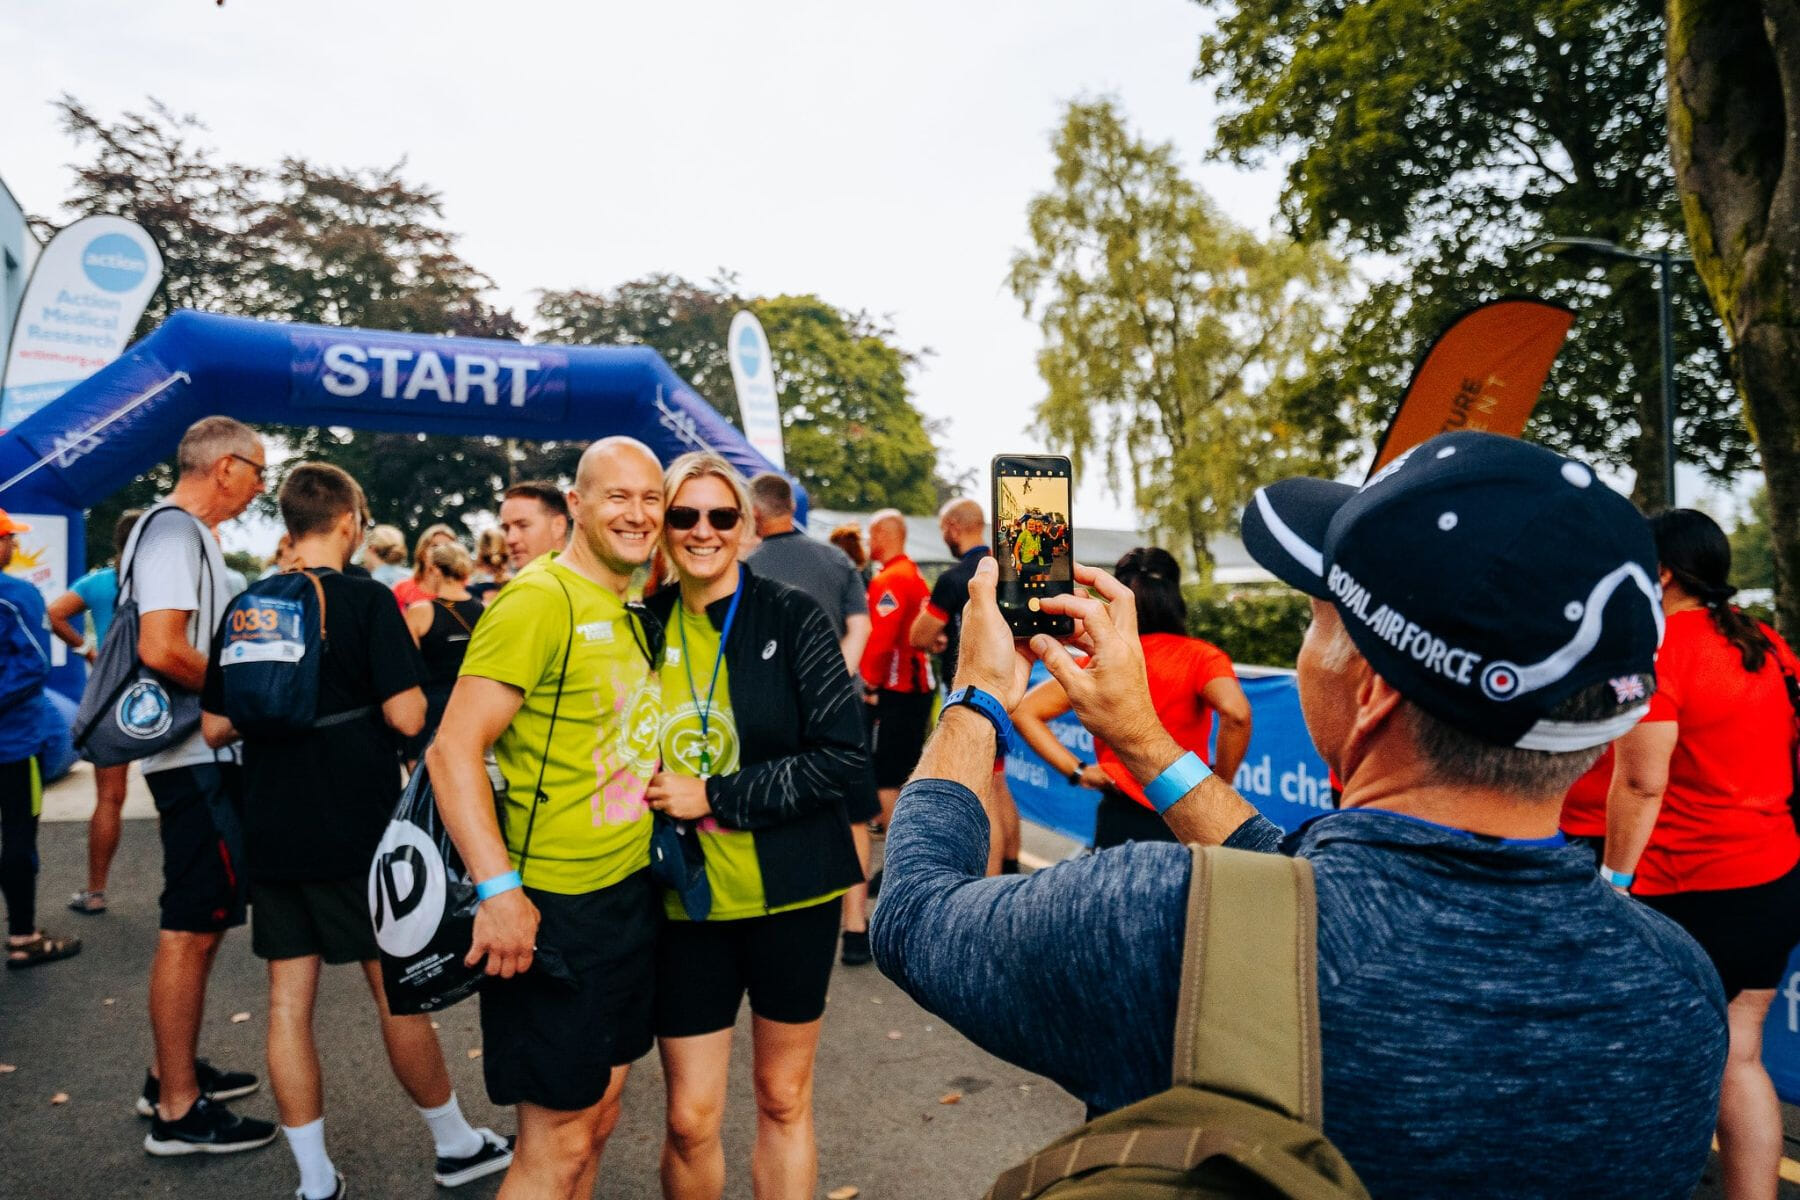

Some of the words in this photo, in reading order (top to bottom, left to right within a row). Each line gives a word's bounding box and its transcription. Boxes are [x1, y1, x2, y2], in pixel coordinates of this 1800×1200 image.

[322, 344, 540, 407] START
[1327, 563, 1371, 621] ROYAL
[1365, 603, 1406, 647] AIR
[1398, 621, 1482, 686] FORCE
[1233, 754, 1271, 796] nd
